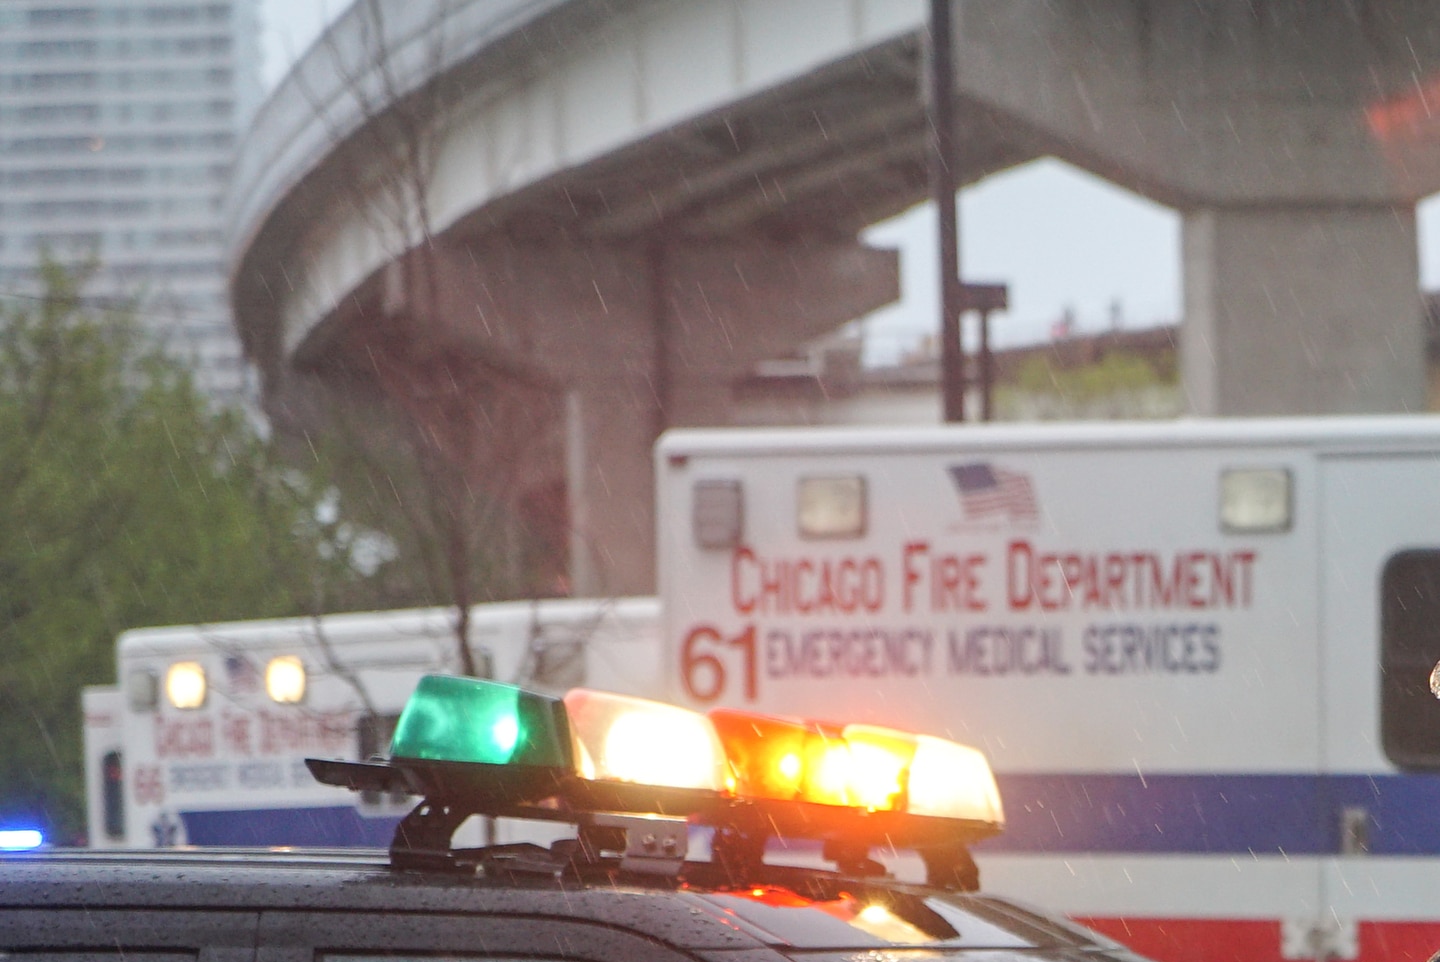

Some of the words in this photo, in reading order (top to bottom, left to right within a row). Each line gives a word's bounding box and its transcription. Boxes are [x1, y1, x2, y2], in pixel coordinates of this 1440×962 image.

[731, 546, 883, 616] CHICAGO
[903, 541, 988, 612] FIRE
[1007, 540, 1257, 610] DEPARTMENT
[682, 623, 759, 701] 61
[767, 626, 935, 677] EMERGENCY
[948, 625, 1070, 675] MEDICAL
[1083, 623, 1221, 675] SERVICES
